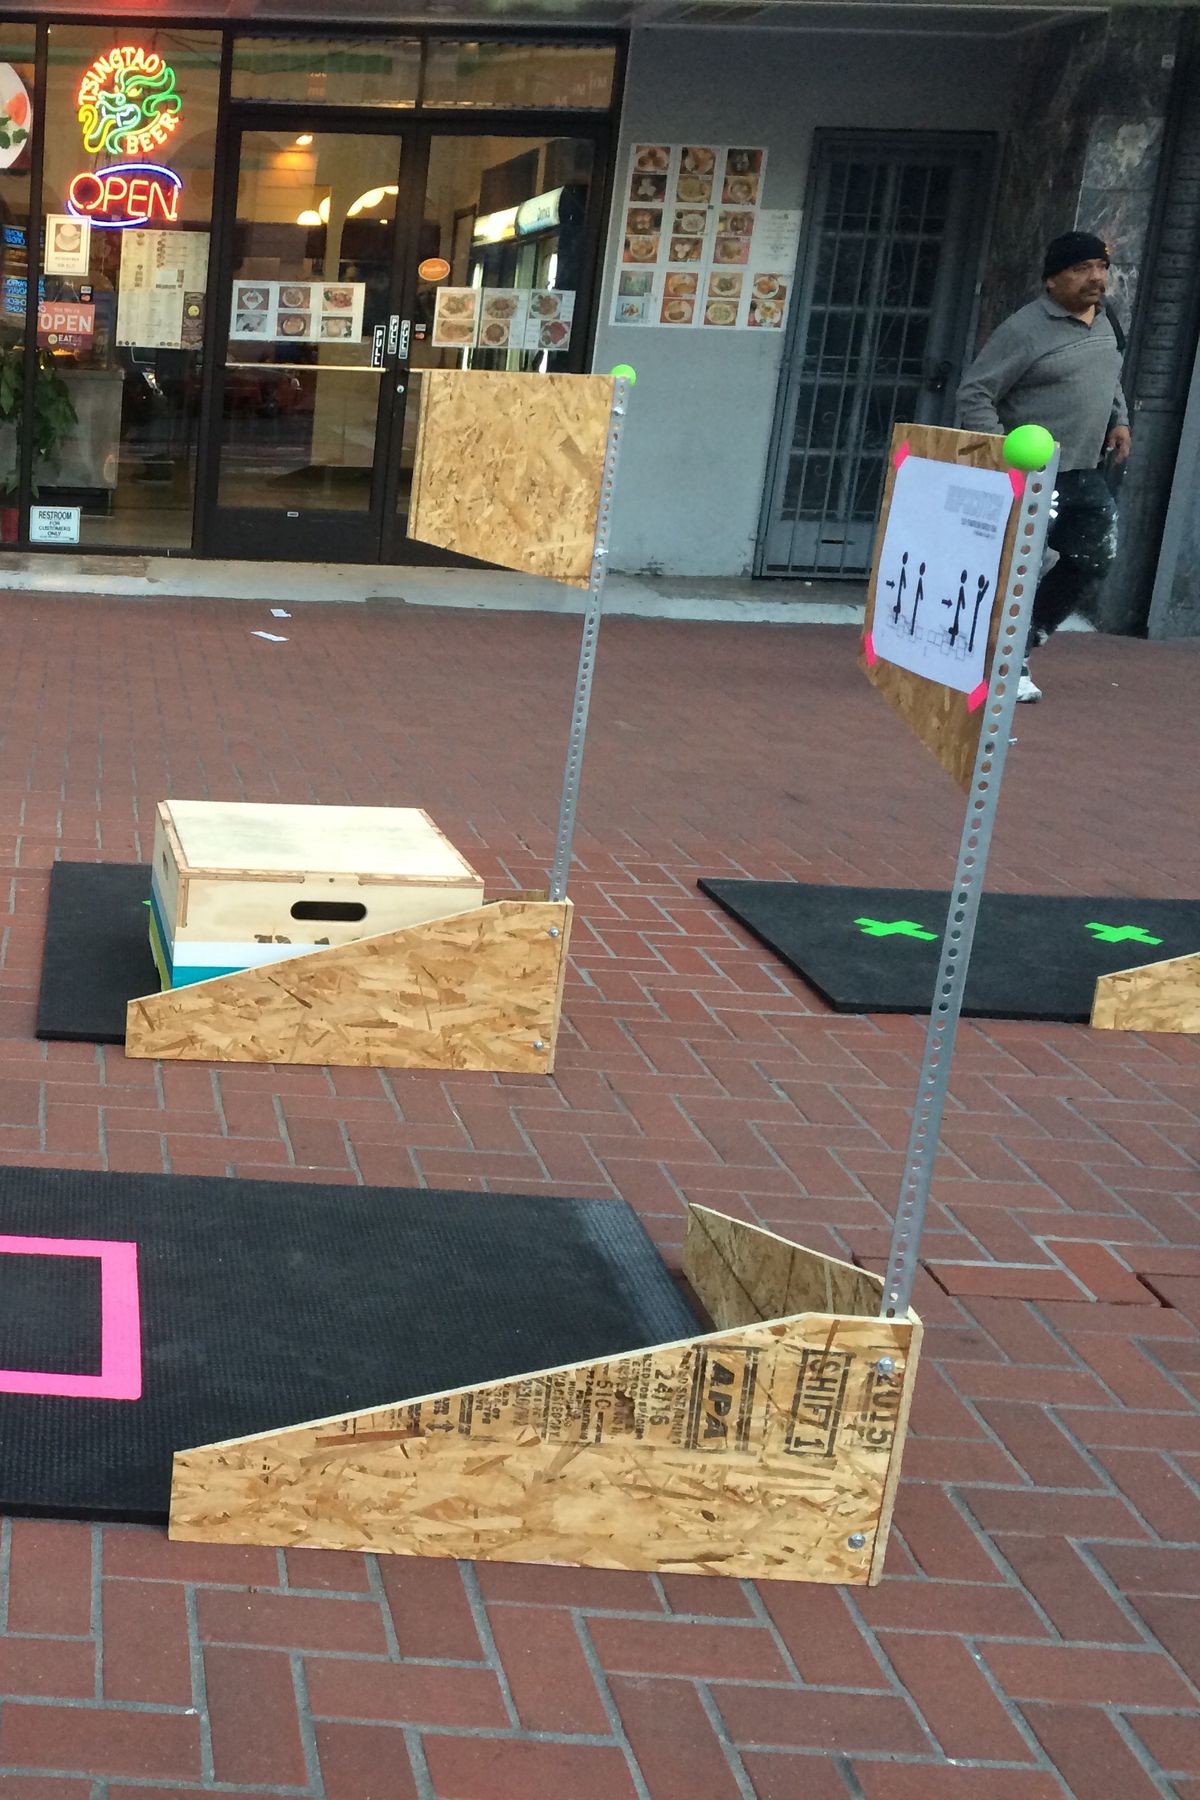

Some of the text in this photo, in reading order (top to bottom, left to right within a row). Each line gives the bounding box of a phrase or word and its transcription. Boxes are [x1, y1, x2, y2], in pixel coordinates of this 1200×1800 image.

[77, 46, 160, 106] TSINGTAO
[126, 109, 180, 155] BEER
[68, 171, 179, 222] OPEN
[40, 313, 93, 332] OPEN
[374, 330, 383, 365] PULL
[38, 510, 72, 520] RESTROOM
[703, 1360, 736, 1440] APA
[800, 1359, 842, 1432] SHIFT
